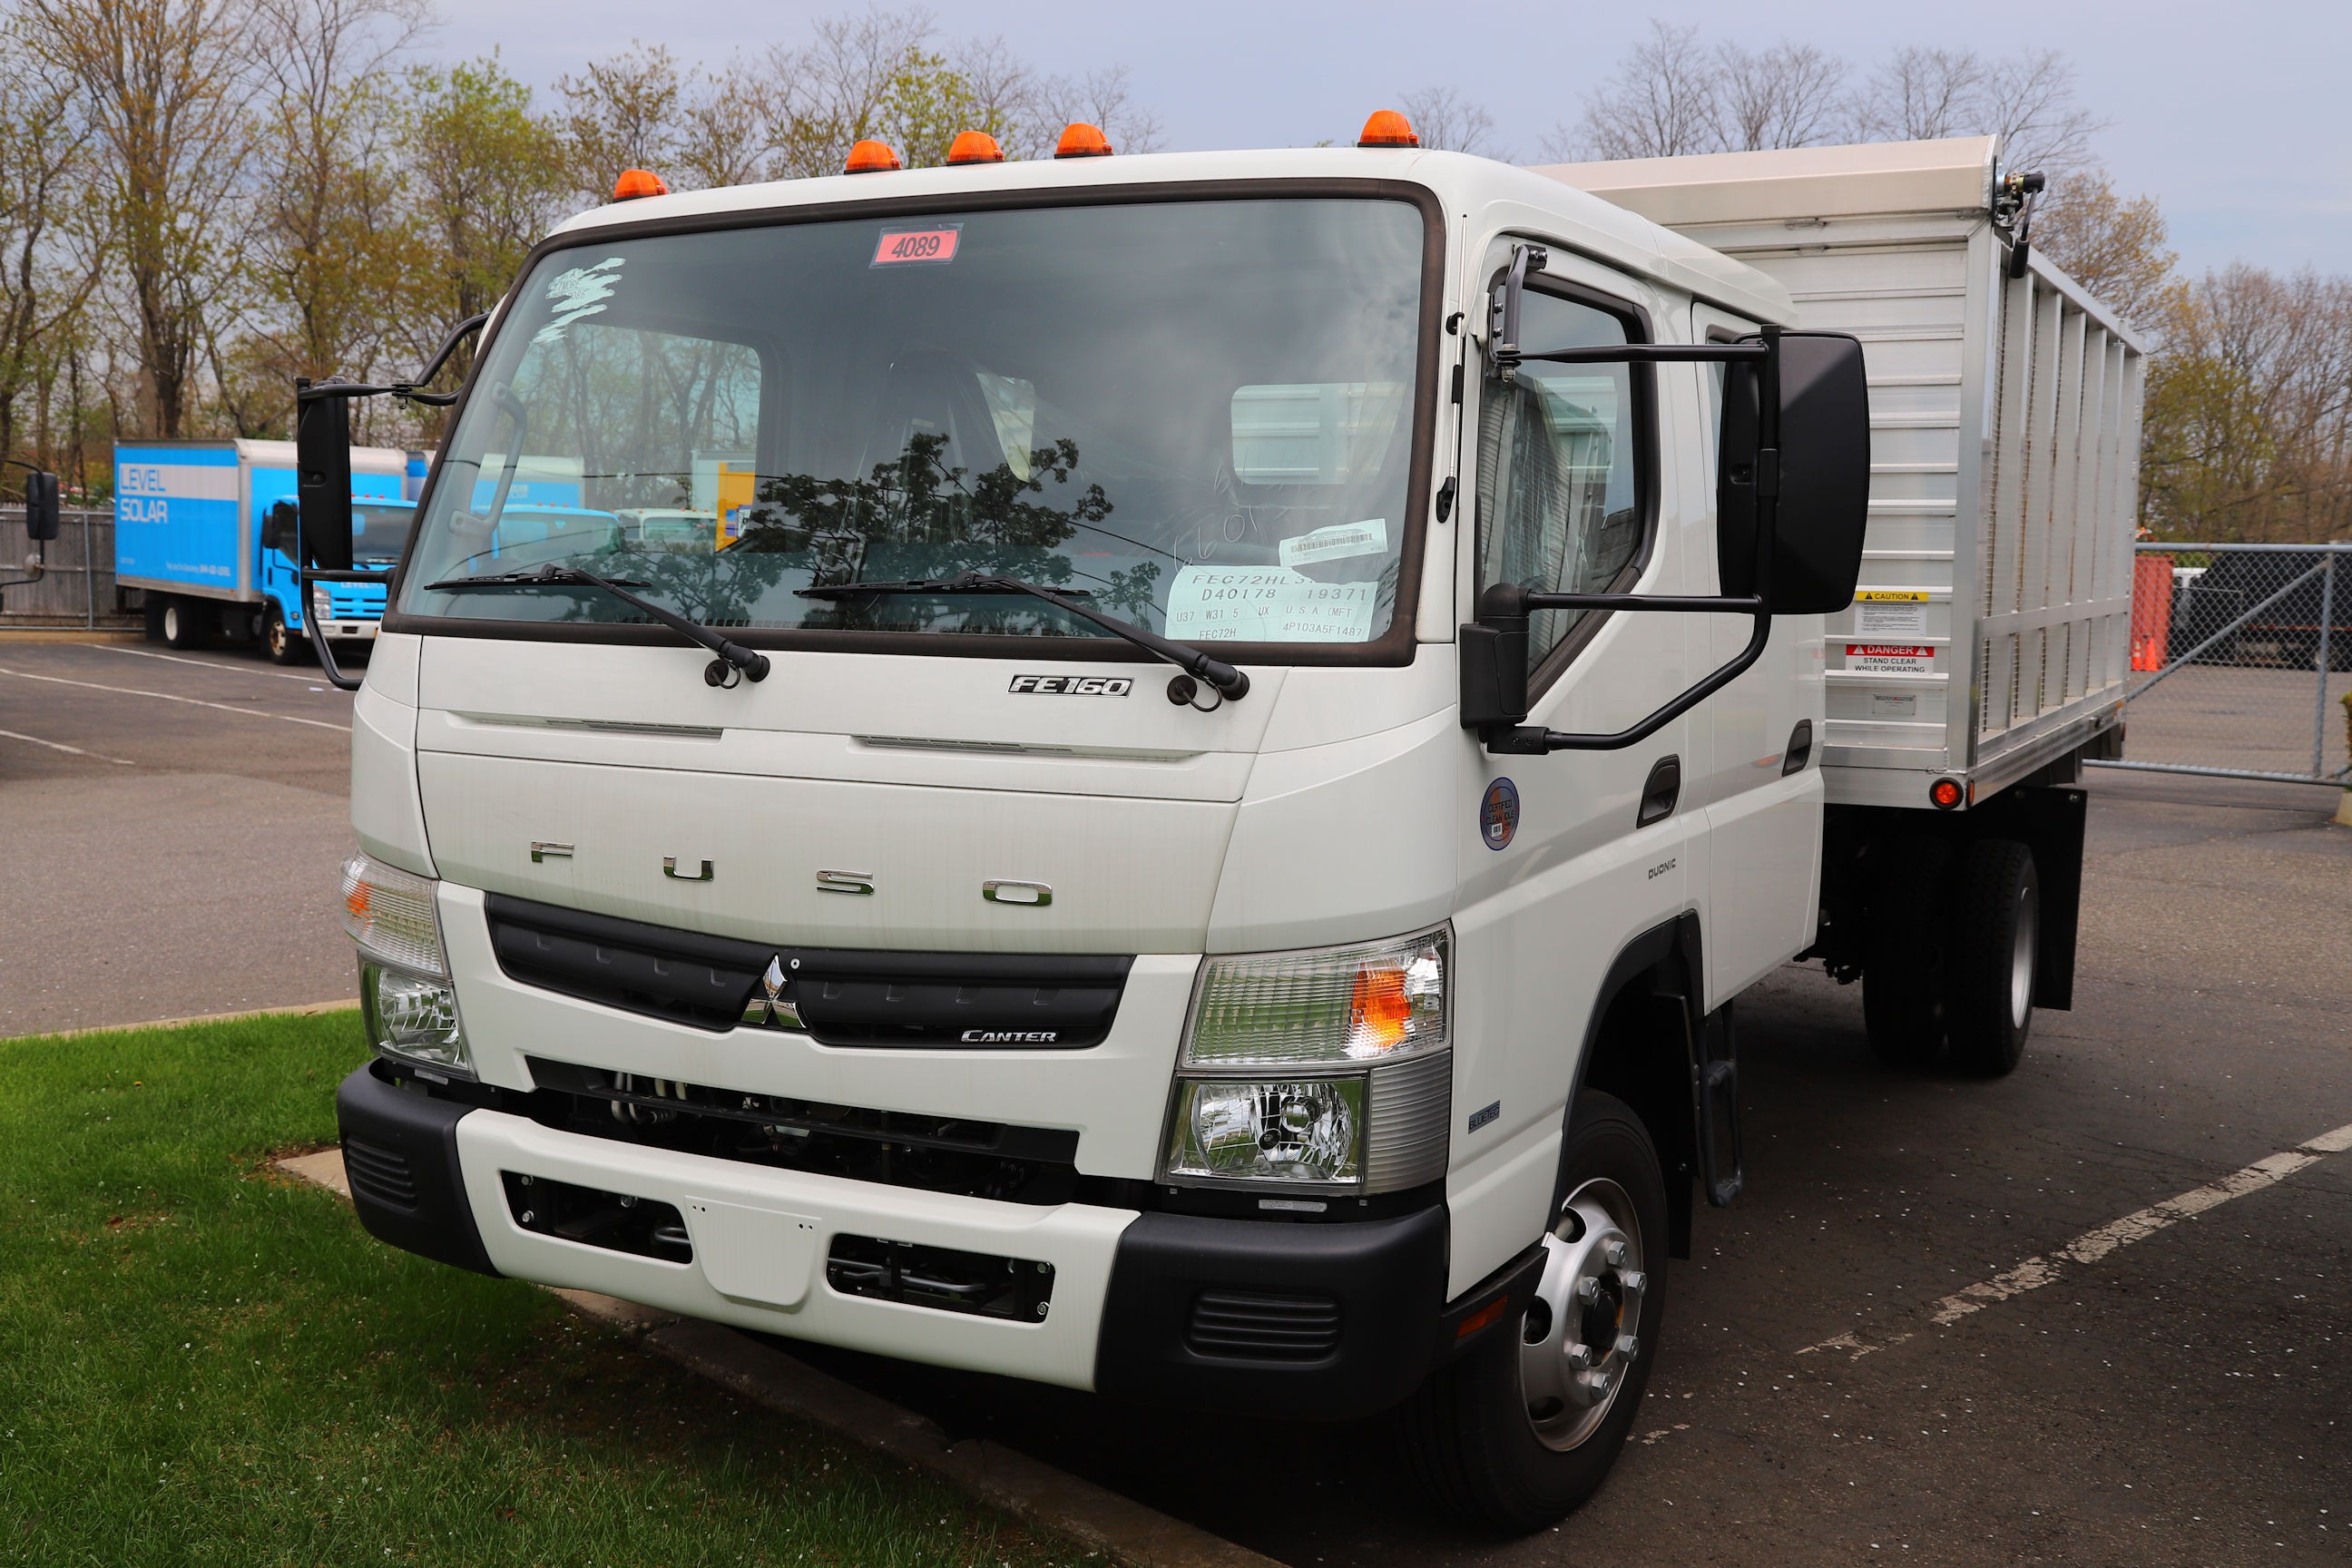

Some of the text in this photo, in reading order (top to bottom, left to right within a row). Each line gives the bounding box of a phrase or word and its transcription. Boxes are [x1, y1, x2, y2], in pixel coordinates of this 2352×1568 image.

[891, 235, 941, 258] 4089
[120, 467, 167, 492] LEVEL
[120, 497, 169, 524] SOLAR
[1201, 588, 1367, 601] D40178 19371
[1176, 611, 1195, 622] U37
[1205, 609, 1224, 621] W31
[1258, 606, 1269, 616] UX
[1199, 627, 1237, 640] FEC72H
[1867, 645, 1915, 654] DANGER
[1880, 665, 1926, 673] OPERATING
[531, 840, 1054, 906] FUSO
